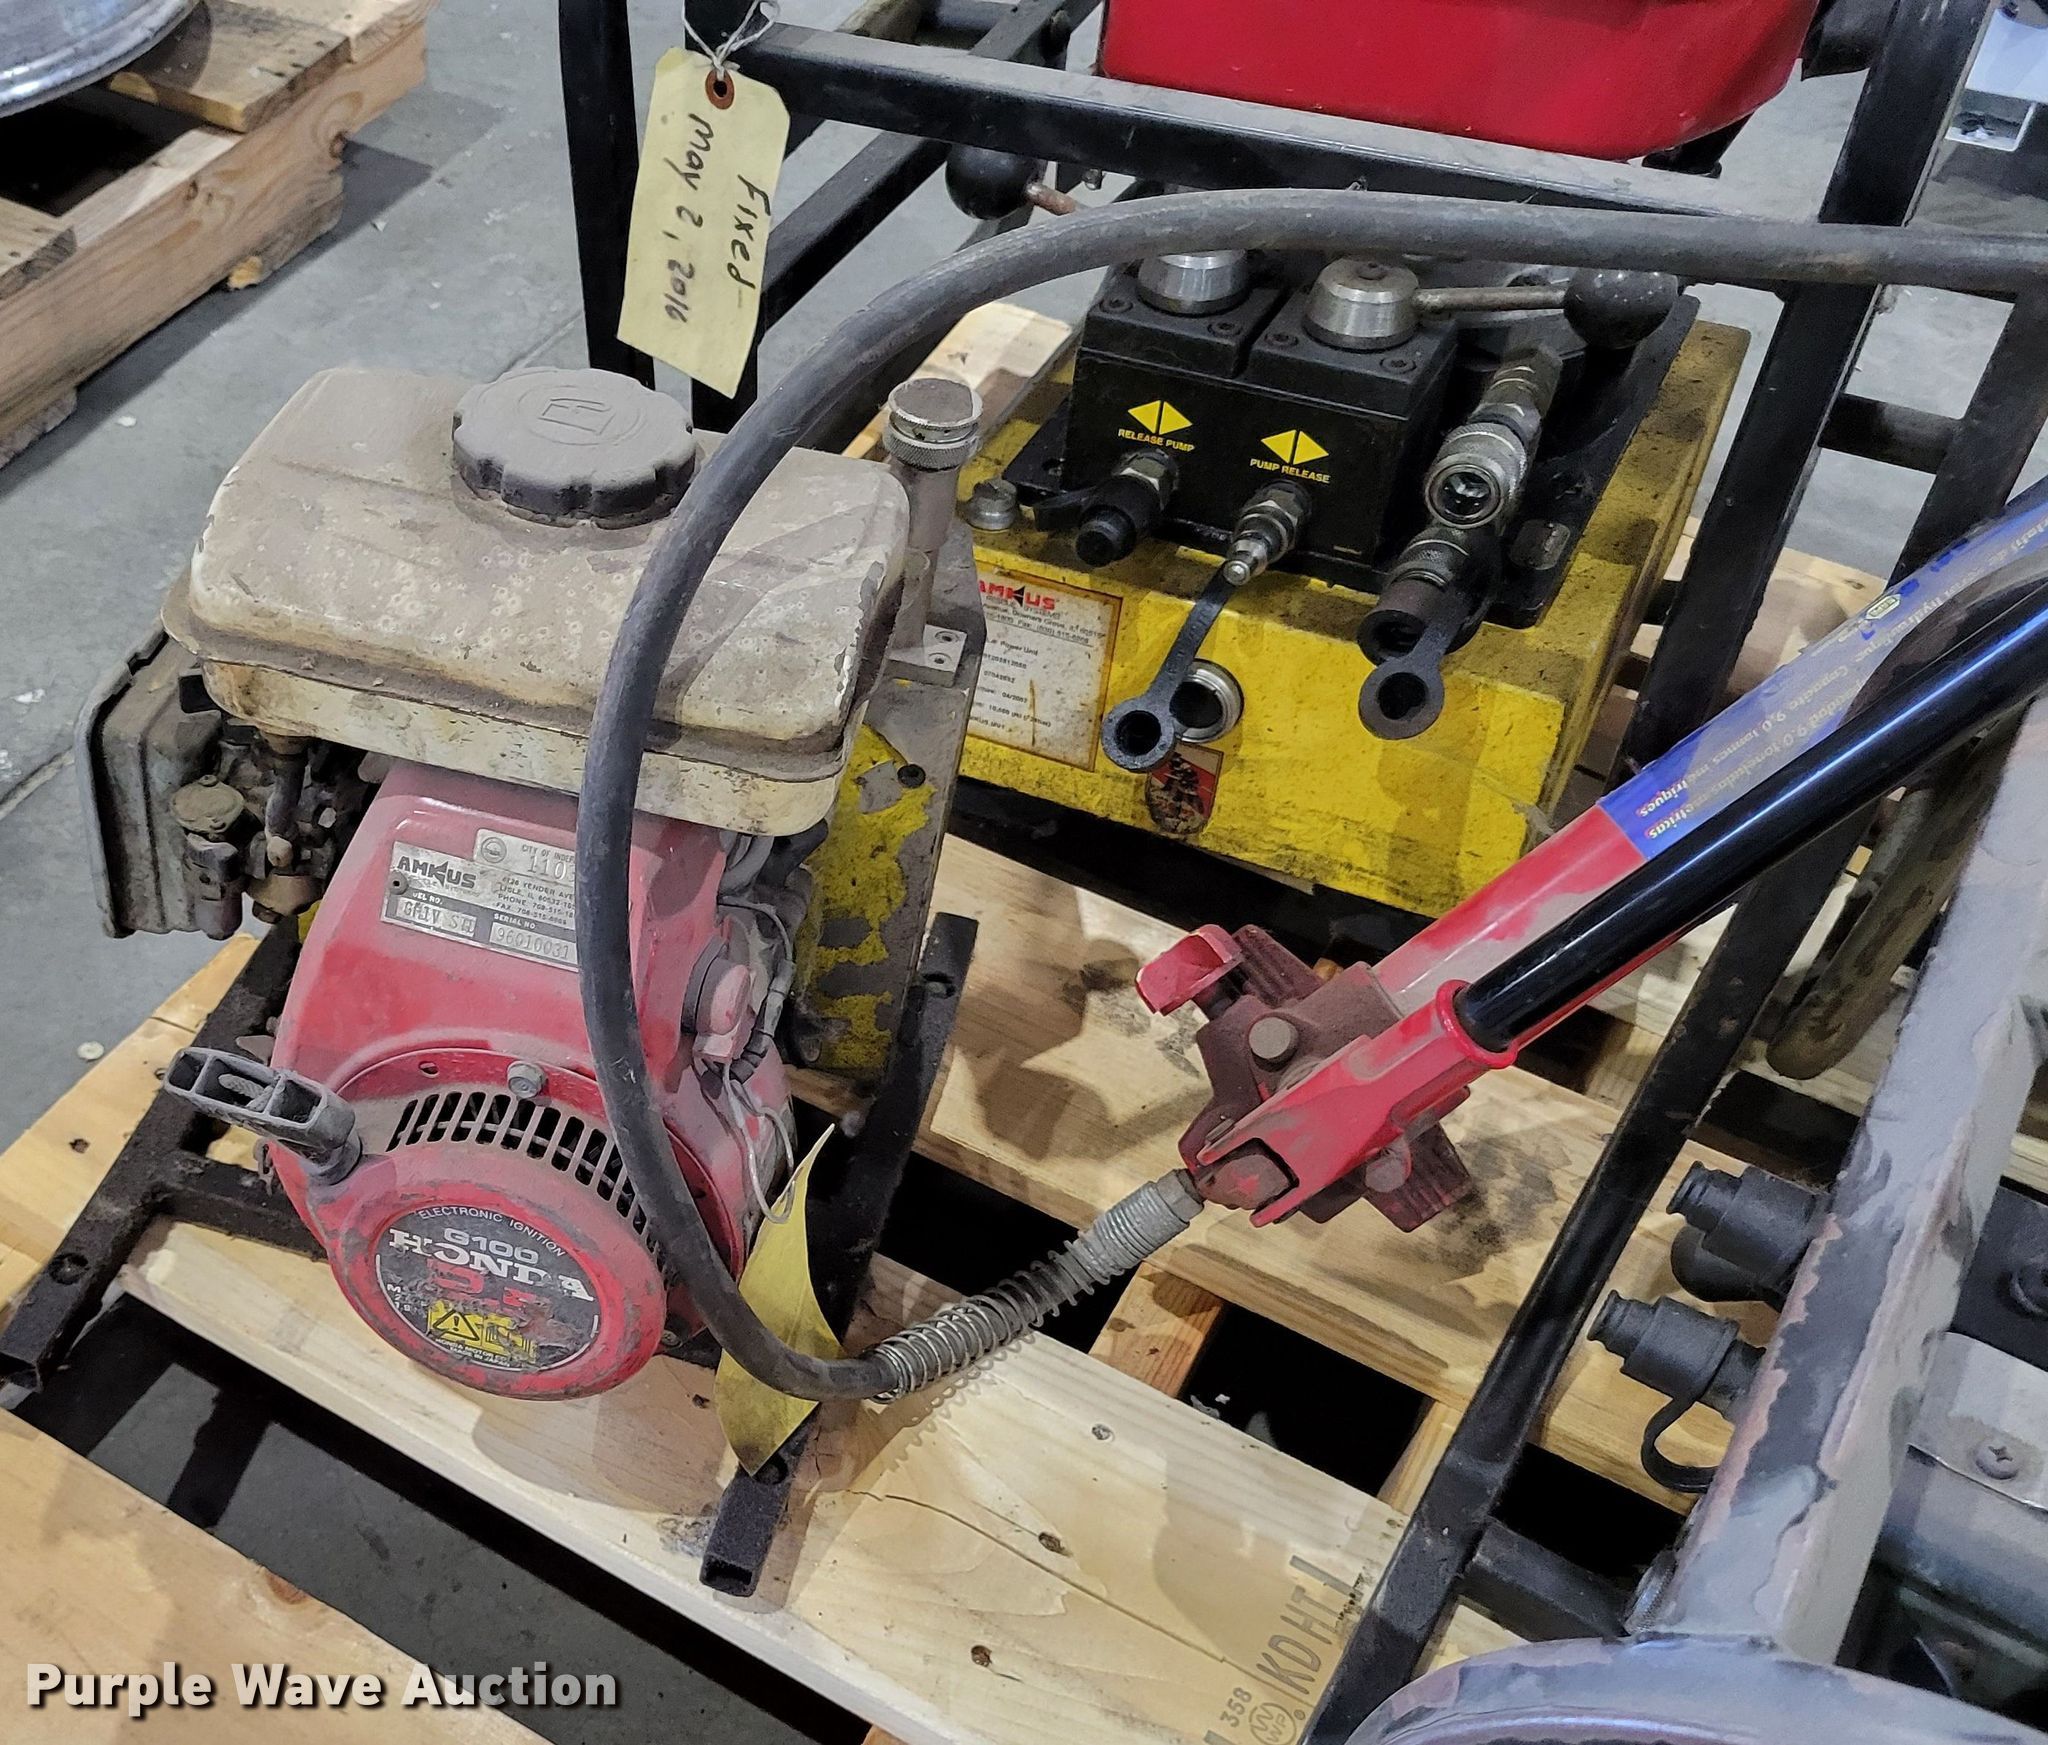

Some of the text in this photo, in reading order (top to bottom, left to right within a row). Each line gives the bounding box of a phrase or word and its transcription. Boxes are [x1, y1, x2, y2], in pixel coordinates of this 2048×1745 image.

[665, 259, 696, 323] 2016
[1118, 428, 1195, 452] RELEASE PUMP
[1250, 458, 1331, 483] PUMP RELEASE
[522, 844, 538, 854] CITY
[541, 849, 551, 857] OF
[397, 856, 476, 888] AMKUS
[494, 913, 522, 925] SERIAL
[419, 1206, 567, 1257] ELECTRONIC IGNITION
[444, 1228, 539, 1264] G100
[389, 1228, 594, 1301] HONDA
[1220, 1687, 1252, 1728] 358
